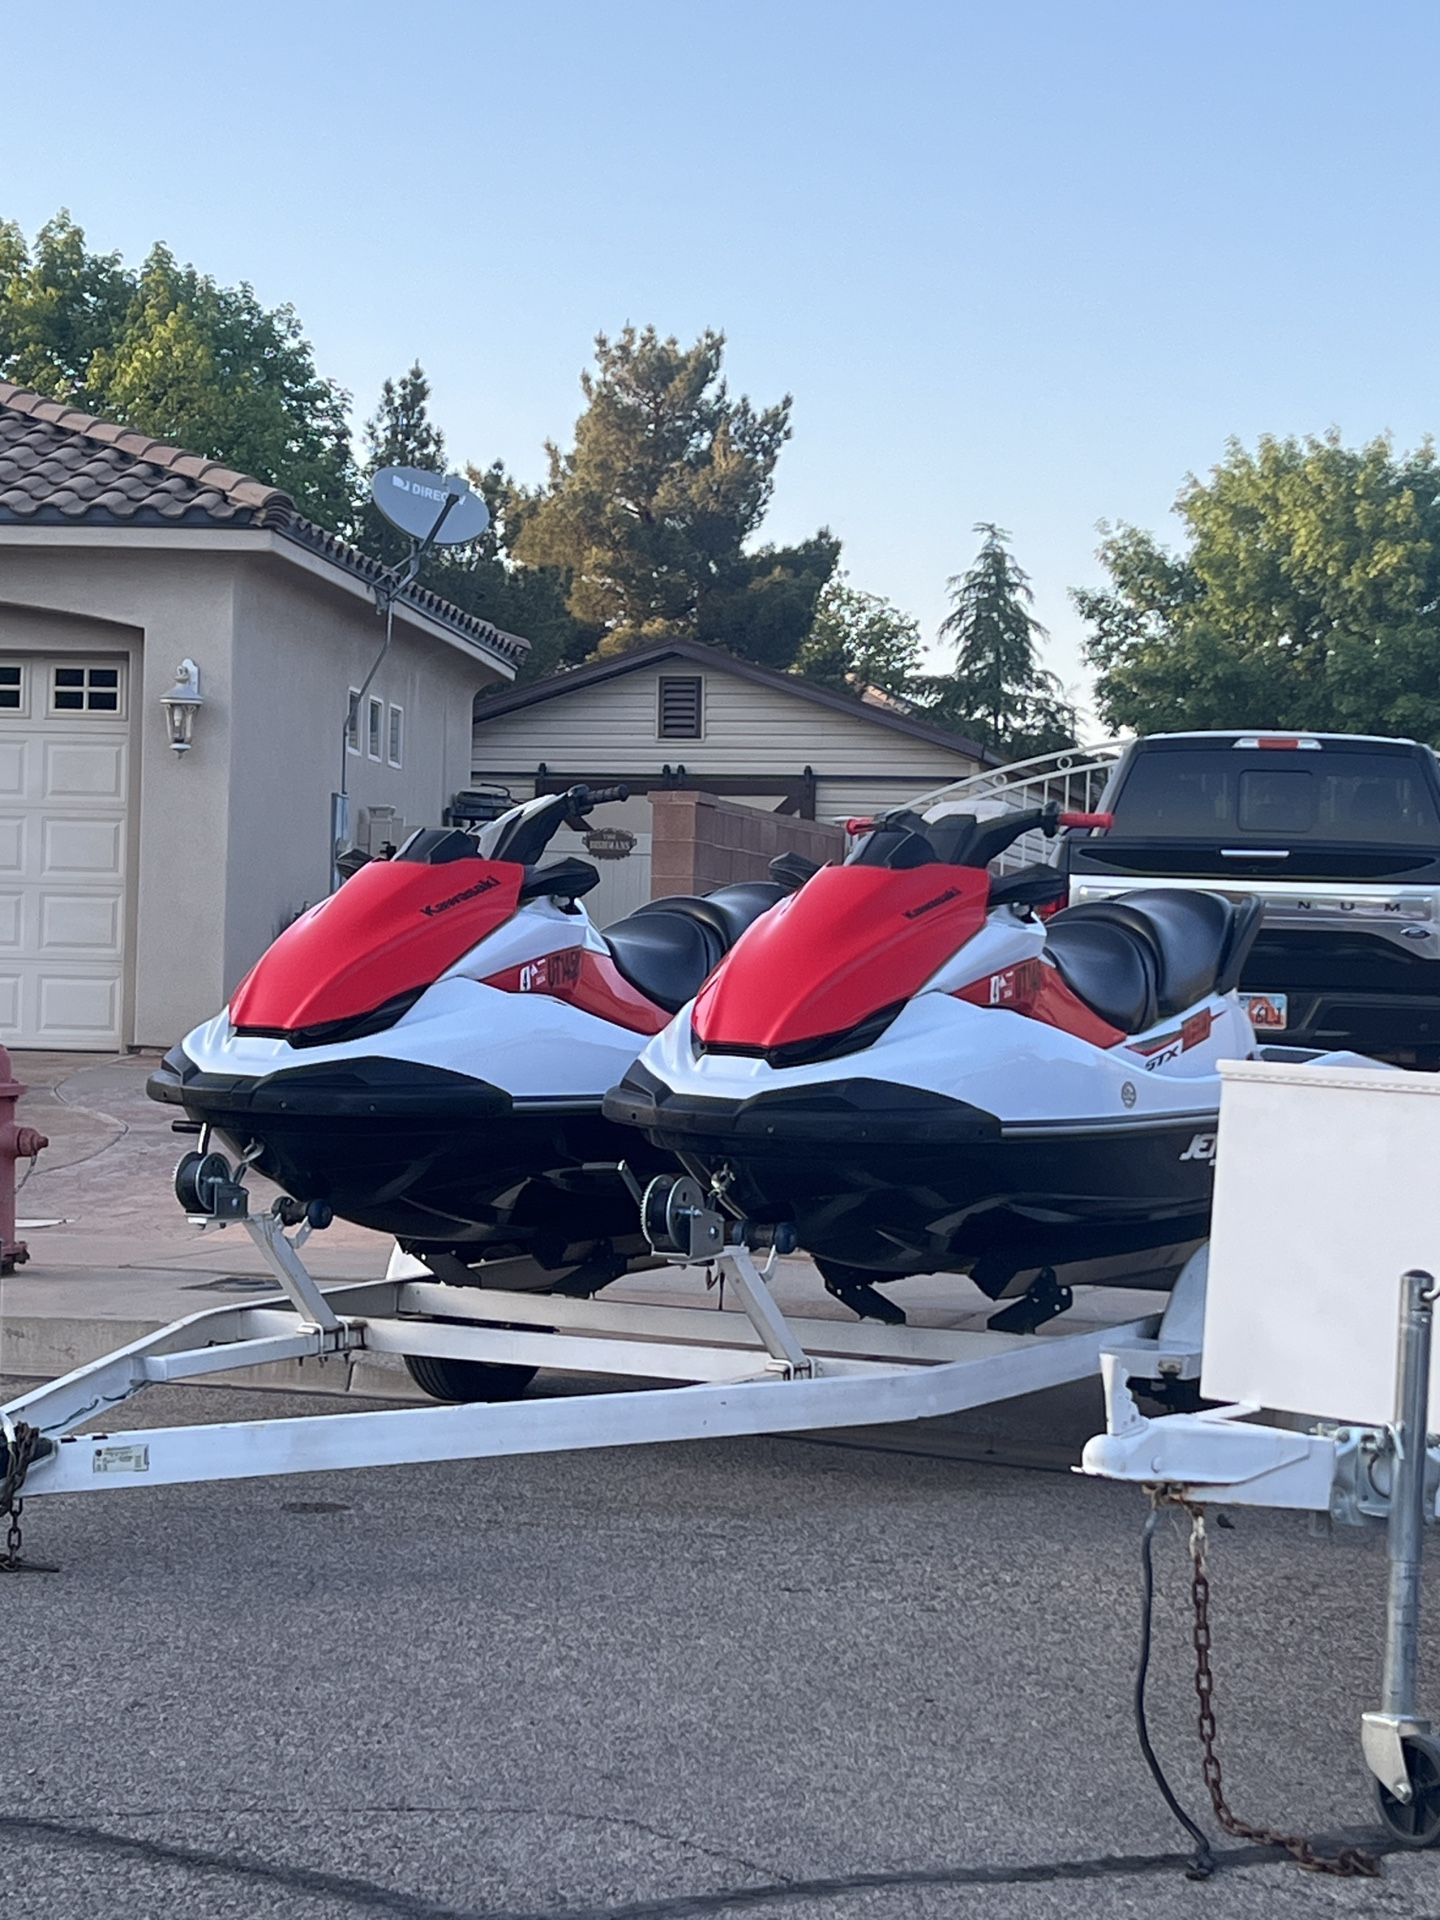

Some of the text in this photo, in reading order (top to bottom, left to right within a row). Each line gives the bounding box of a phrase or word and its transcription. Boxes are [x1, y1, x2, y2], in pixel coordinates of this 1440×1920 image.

[412, 483, 467, 505] DIRECV
[420, 876, 501, 917] Kawasaki
[1145, 1045, 1178, 1071] STX
